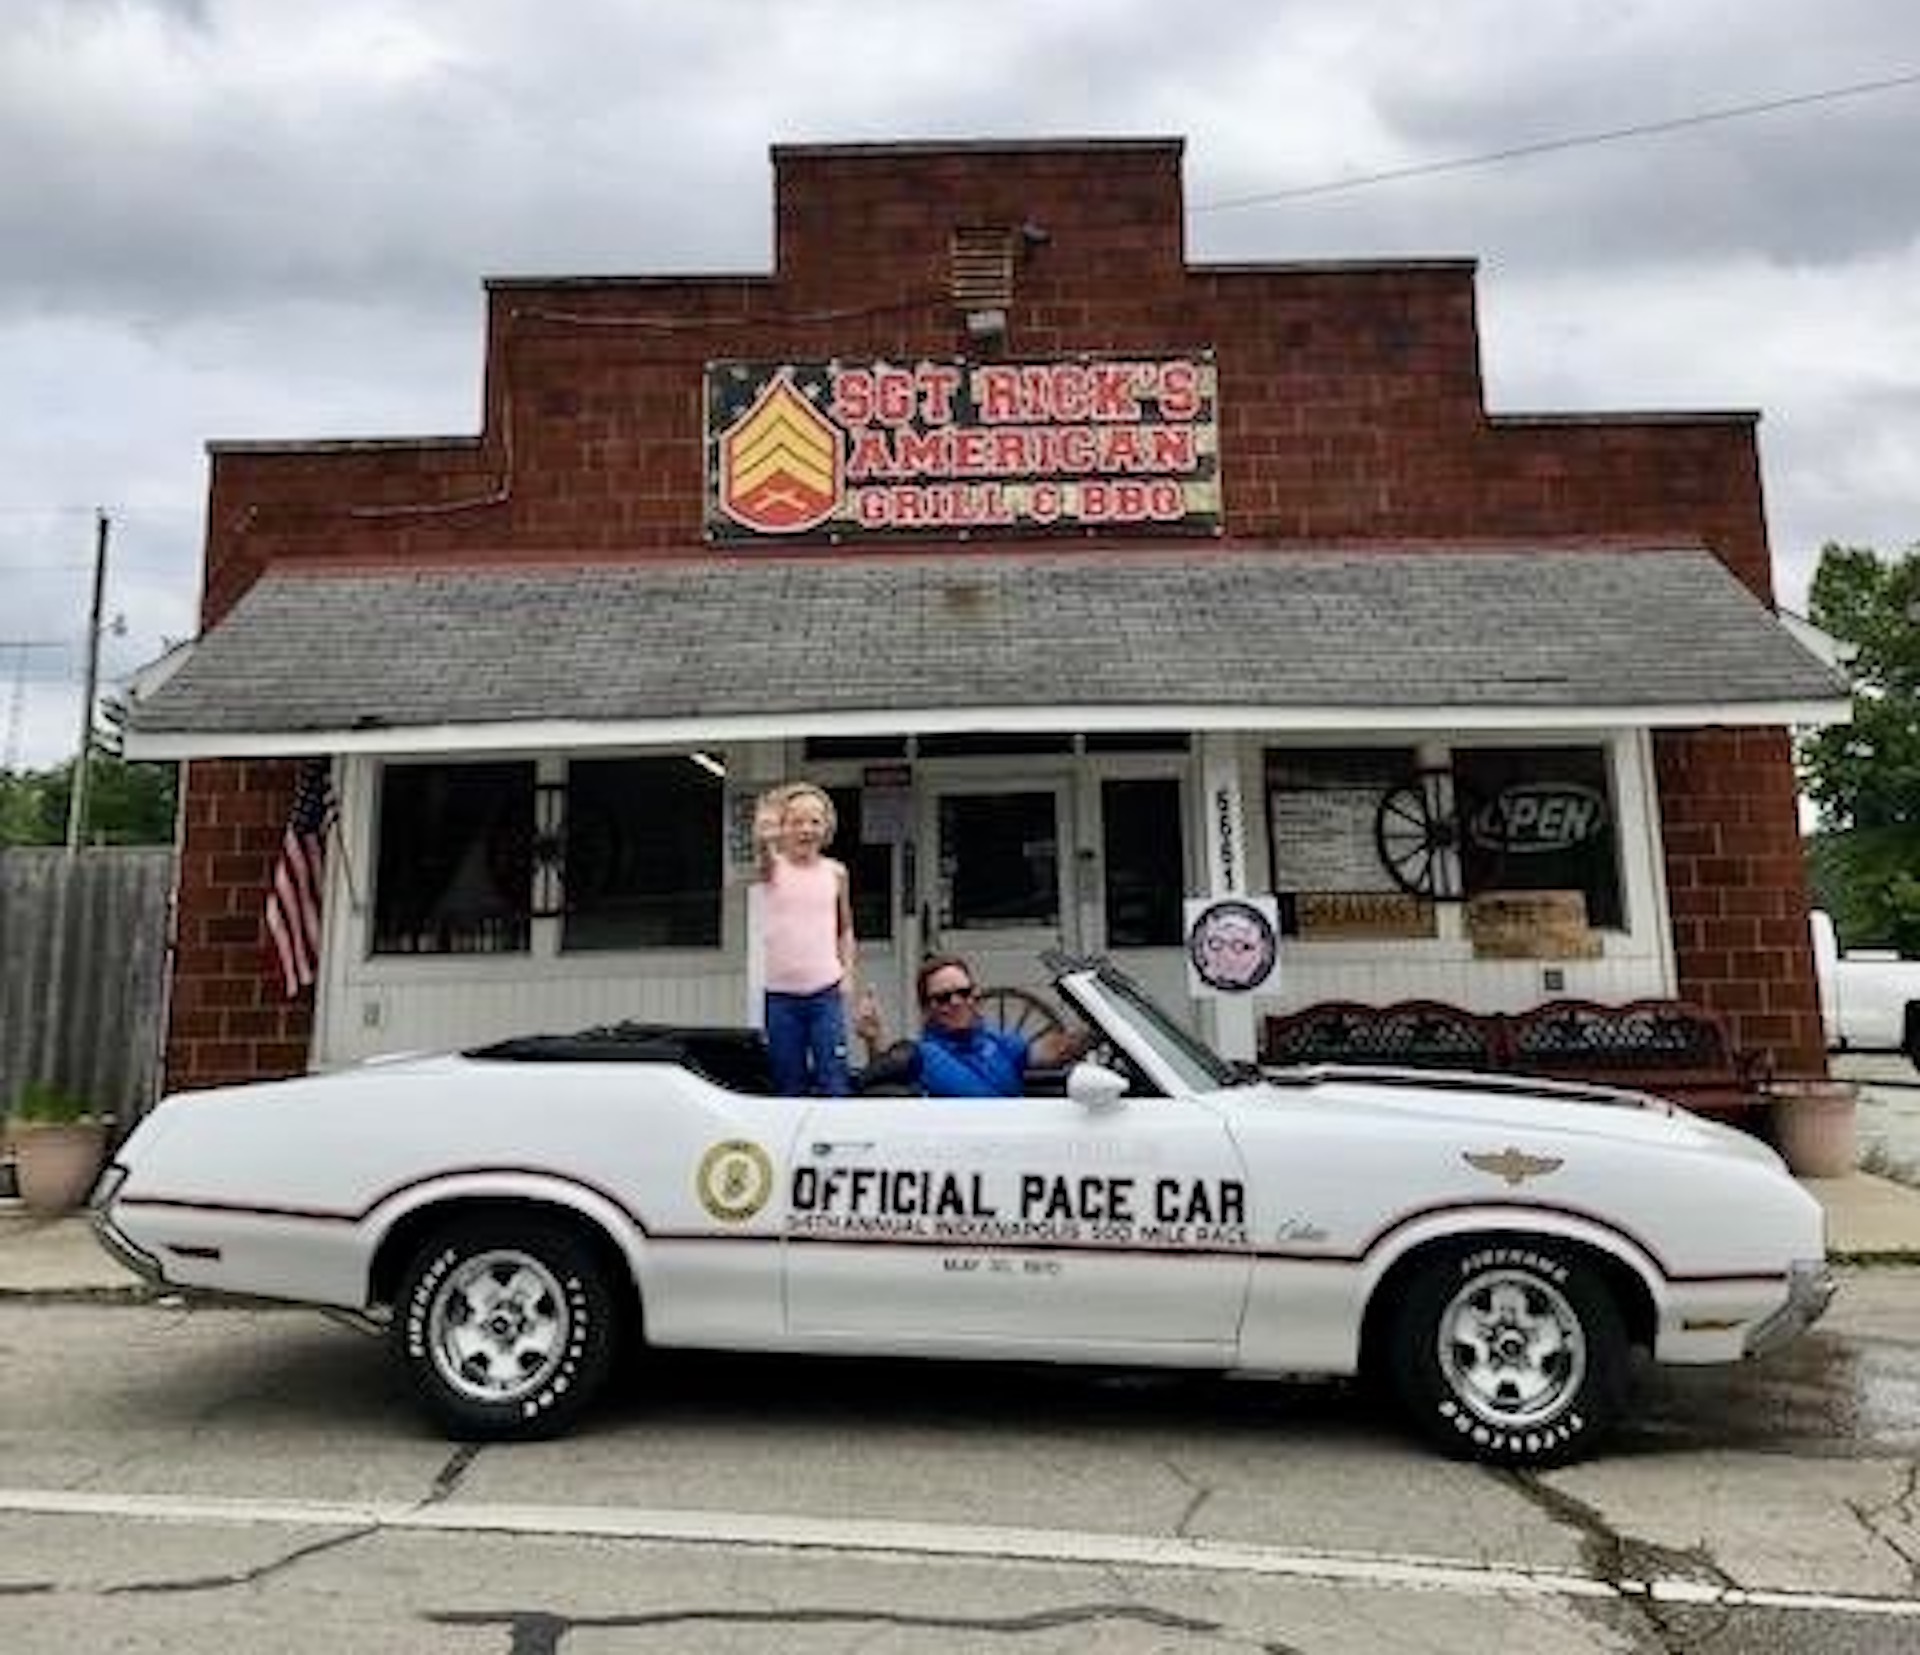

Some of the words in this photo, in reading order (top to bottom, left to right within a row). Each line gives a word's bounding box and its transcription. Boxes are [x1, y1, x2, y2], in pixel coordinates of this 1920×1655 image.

[833, 369, 960, 424] SGT
[978, 362, 1200, 421] RICK'S
[847, 425, 1199, 478] AMERICAN
[858, 484, 1014, 526] GRILL
[1078, 479, 1186, 521] BBQ
[1476, 796, 1596, 842] OPEN
[792, 1167, 996, 1218] OFFICIAL
[1021, 1174, 1134, 1222] PACE
[1156, 1179, 1246, 1224] CAR
[1140, 1226, 1187, 1244] MILE
